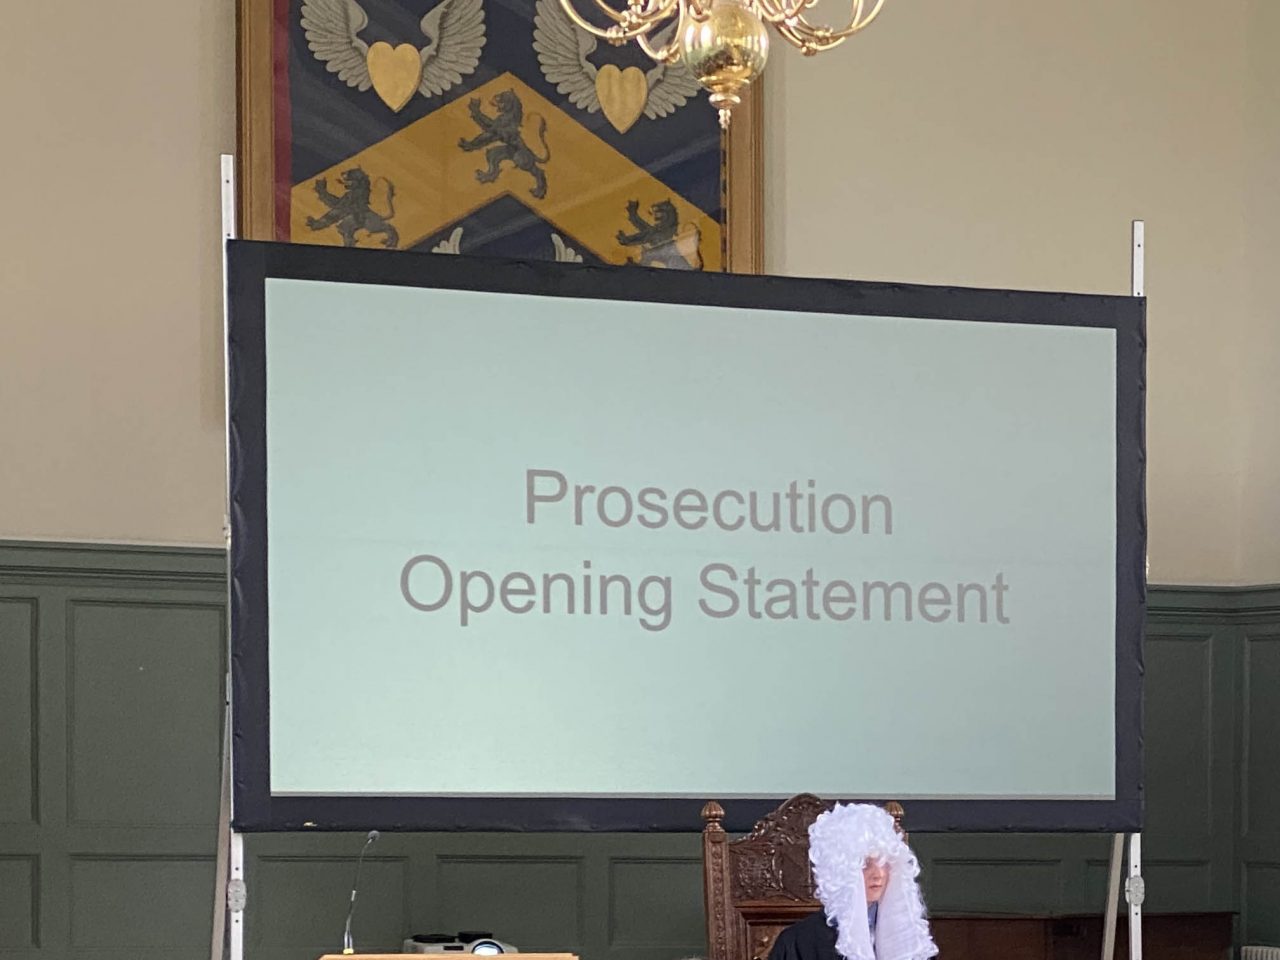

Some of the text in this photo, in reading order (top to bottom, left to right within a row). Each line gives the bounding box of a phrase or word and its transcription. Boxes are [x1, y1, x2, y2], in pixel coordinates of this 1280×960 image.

[525, 468, 894, 535] Prosecution
[400, 554, 1010, 632] Opening Statement
